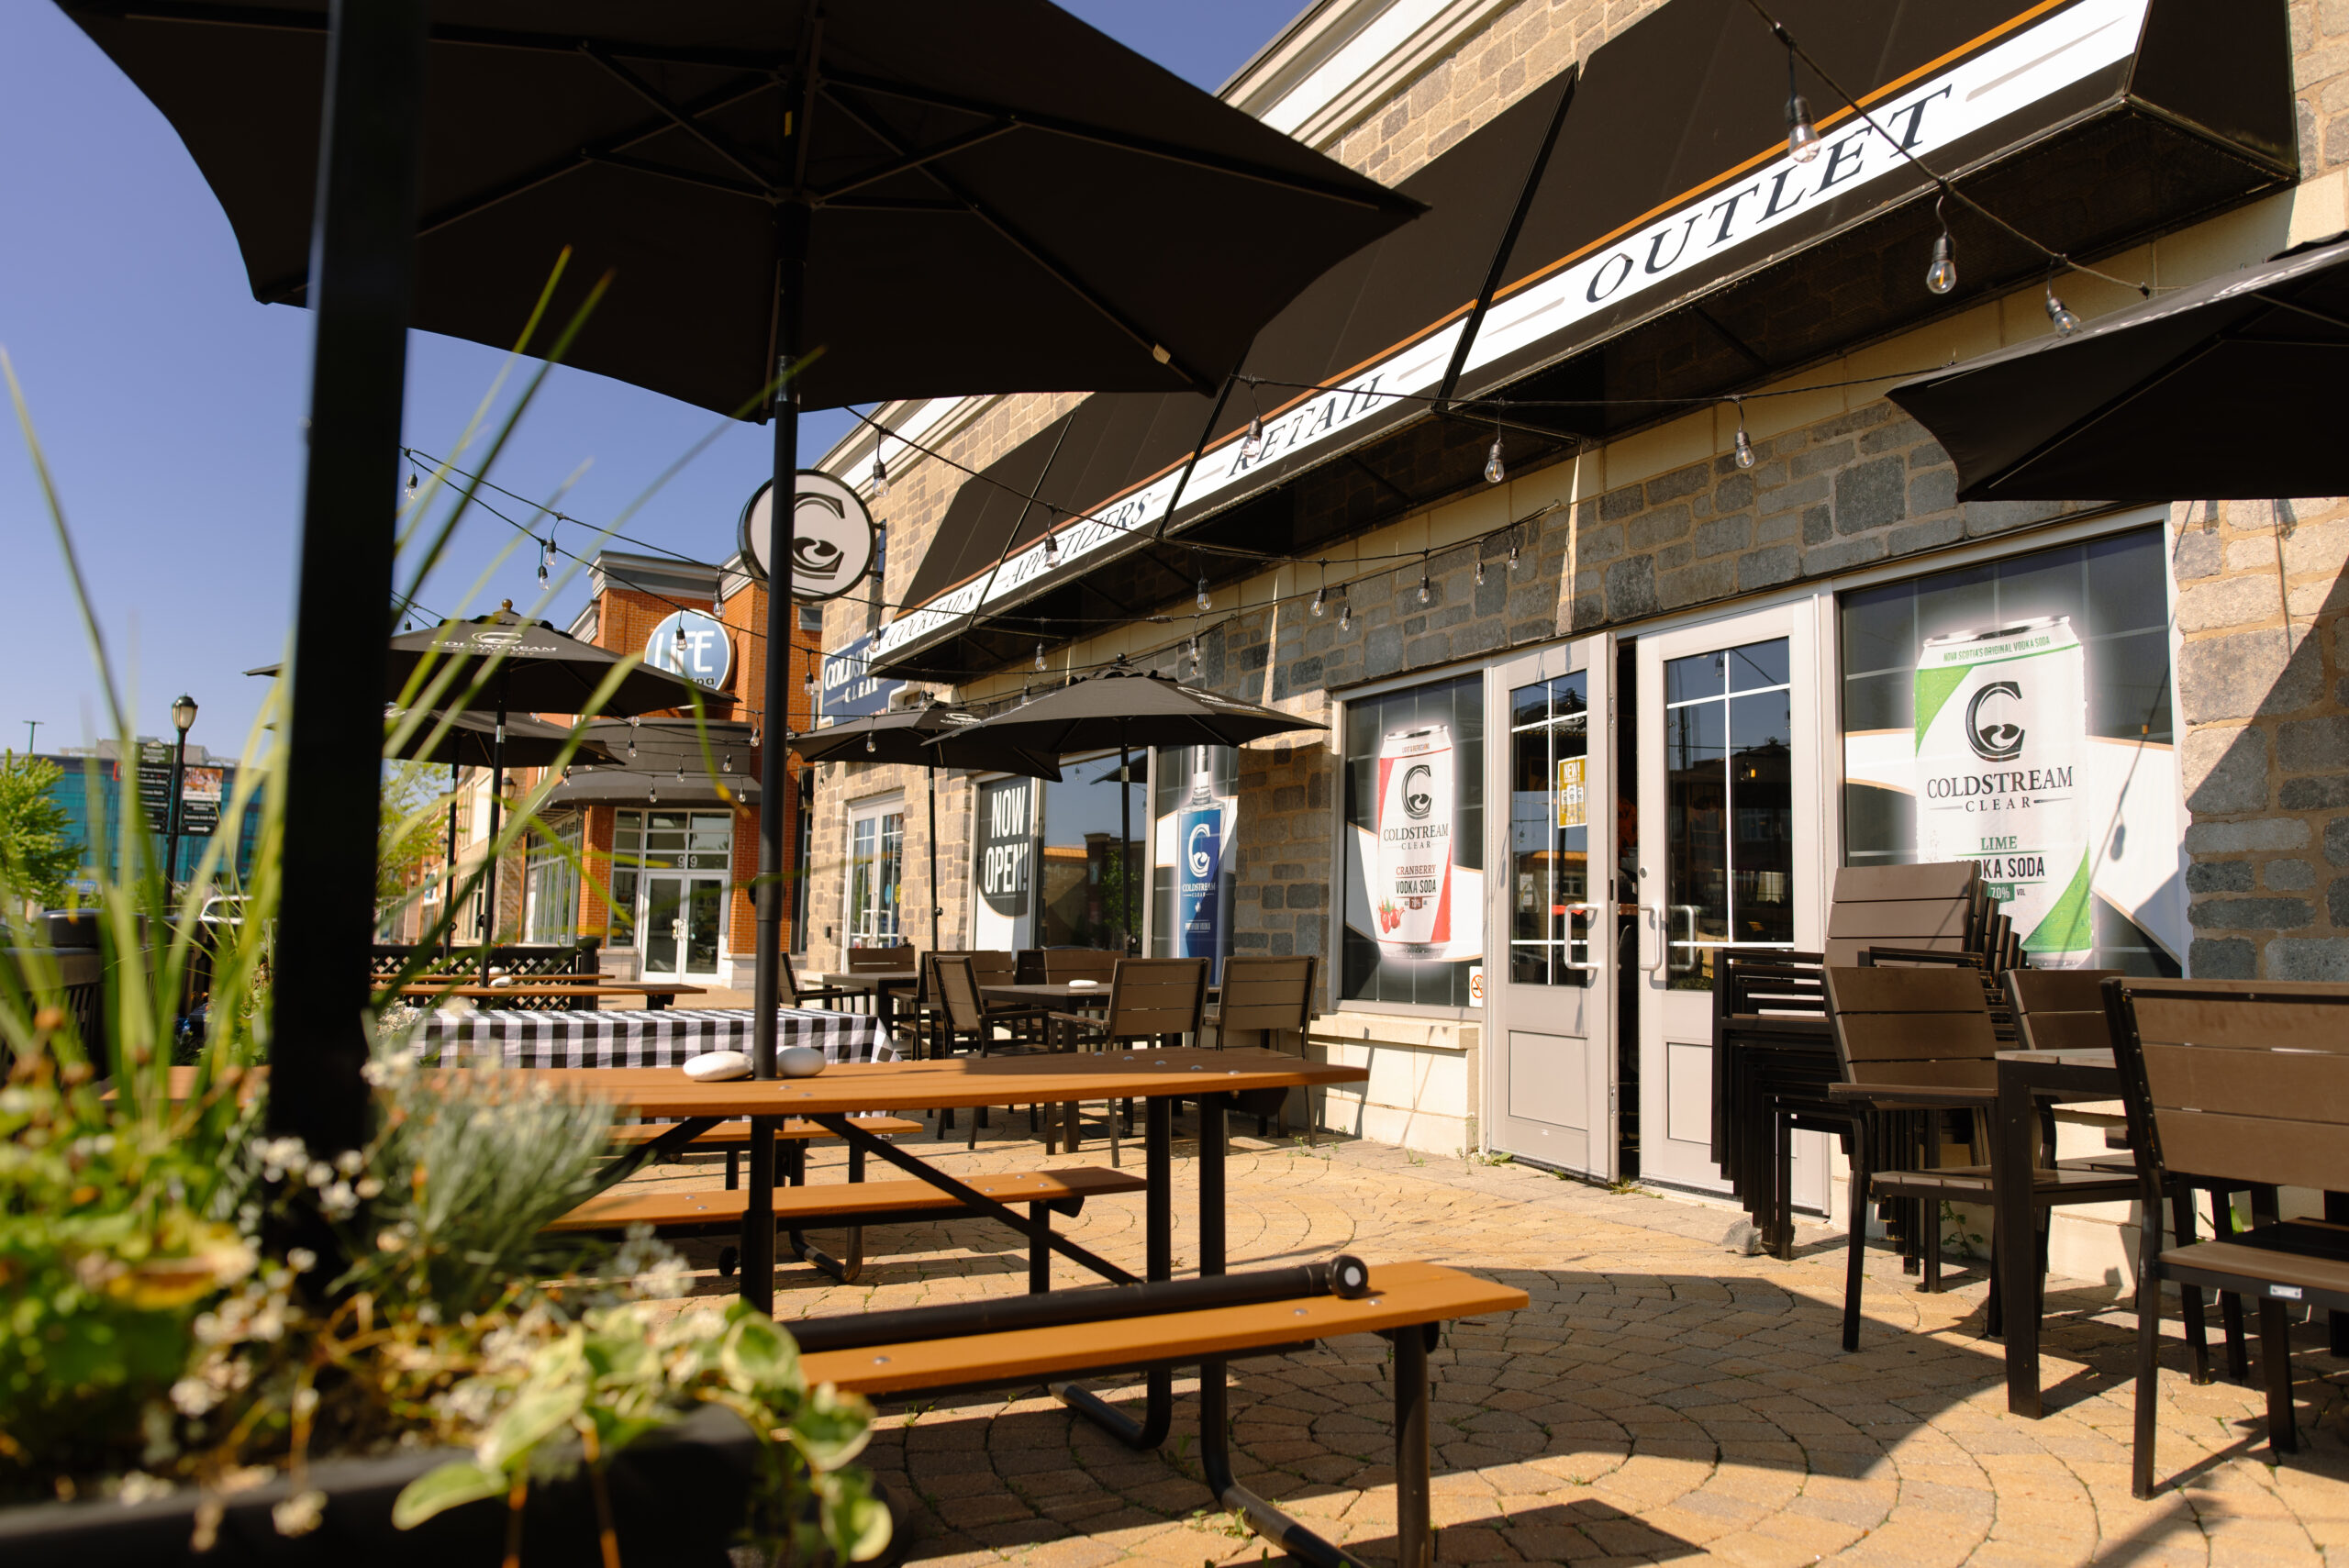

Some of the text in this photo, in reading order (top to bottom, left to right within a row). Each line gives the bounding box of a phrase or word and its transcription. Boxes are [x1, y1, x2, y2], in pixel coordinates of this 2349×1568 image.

[1004, 493, 1152, 588] APPTIZERS
[1585, 83, 1954, 304] OUTLET
[654, 630, 716, 674] LIFE
[1943, 636, 2051, 662] NOVA SCOTIA'S ORIGINAL VODKA SODA
[825, 644, 870, 691] COLDST
[844, 676, 879, 704] CLEAR
[1564, 762, 1581, 779] NEW!
[1927, 765, 2074, 799] COLDSTREAM
[991, 786, 1027, 839] NOW
[1965, 796, 2032, 813] CLEAR
[1383, 822, 1449, 841] COLDSTREAM
[1401, 840, 1431, 850] CLEAR
[1980, 836, 2018, 851] LIME
[985, 842, 1029, 895] OPEN!
[1396, 864, 1437, 875] CRANBERRY
[2008, 856, 2045, 878] SODA
[1182, 883, 1216, 892] COLDSTREAM
[1395, 879, 1437, 895] VODKA SODA
